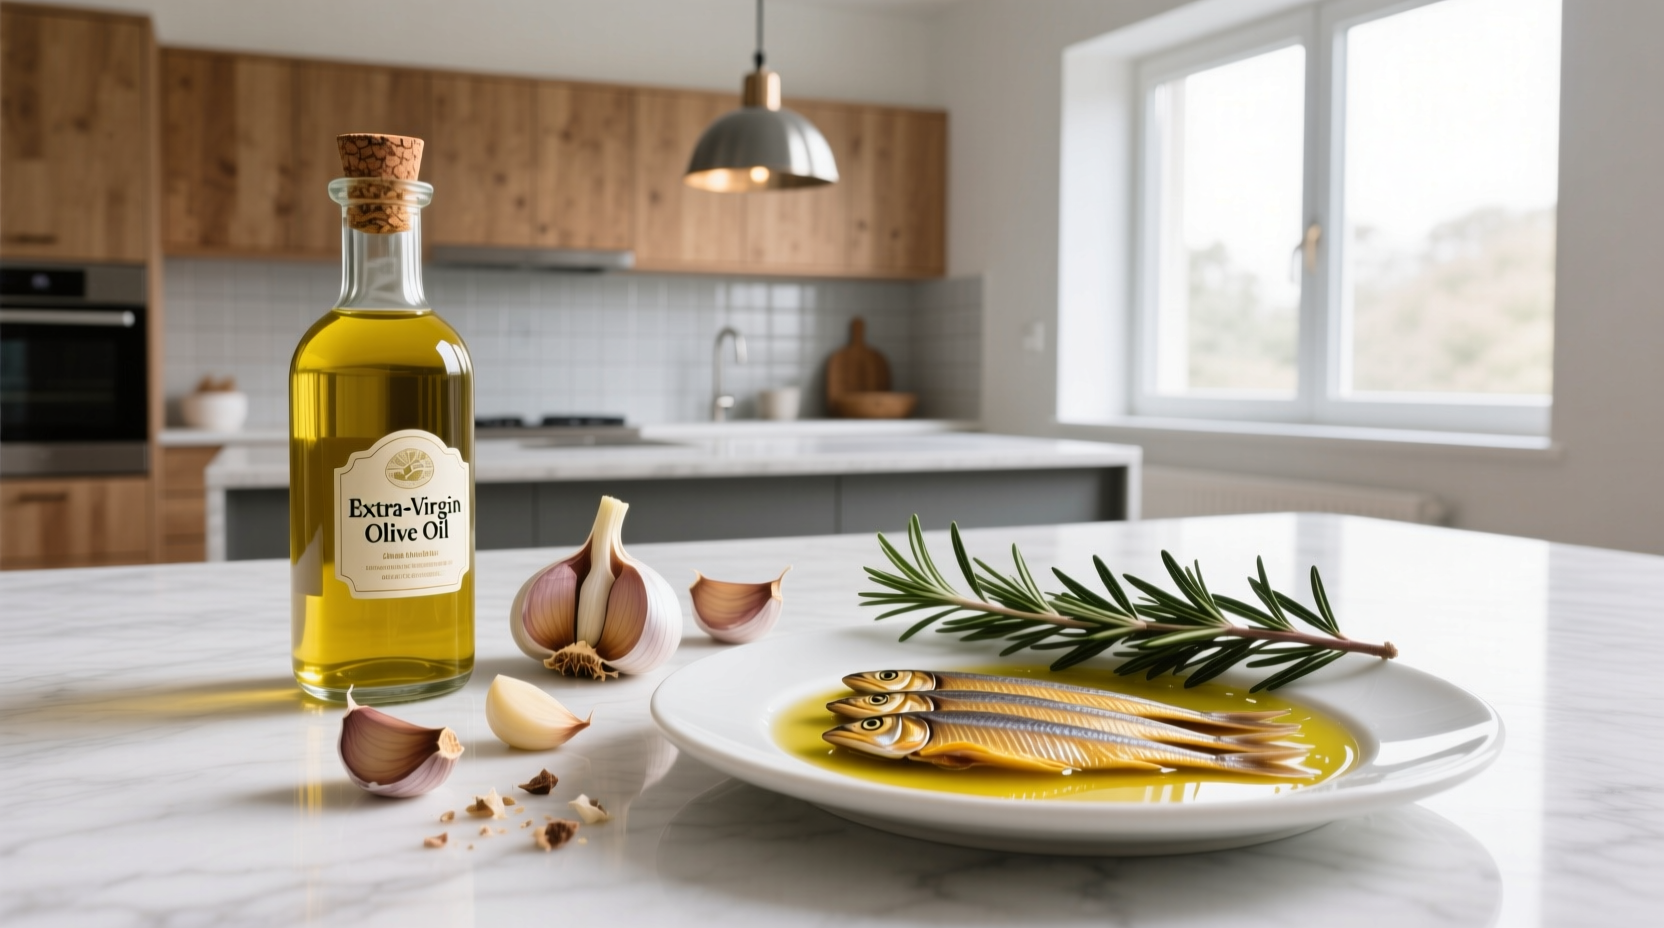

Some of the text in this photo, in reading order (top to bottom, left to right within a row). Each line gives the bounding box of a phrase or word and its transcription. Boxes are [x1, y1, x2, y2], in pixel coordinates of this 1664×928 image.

[349, 496, 461, 520] Extra-Virgin
[365, 519, 449, 543] Olive Oil
